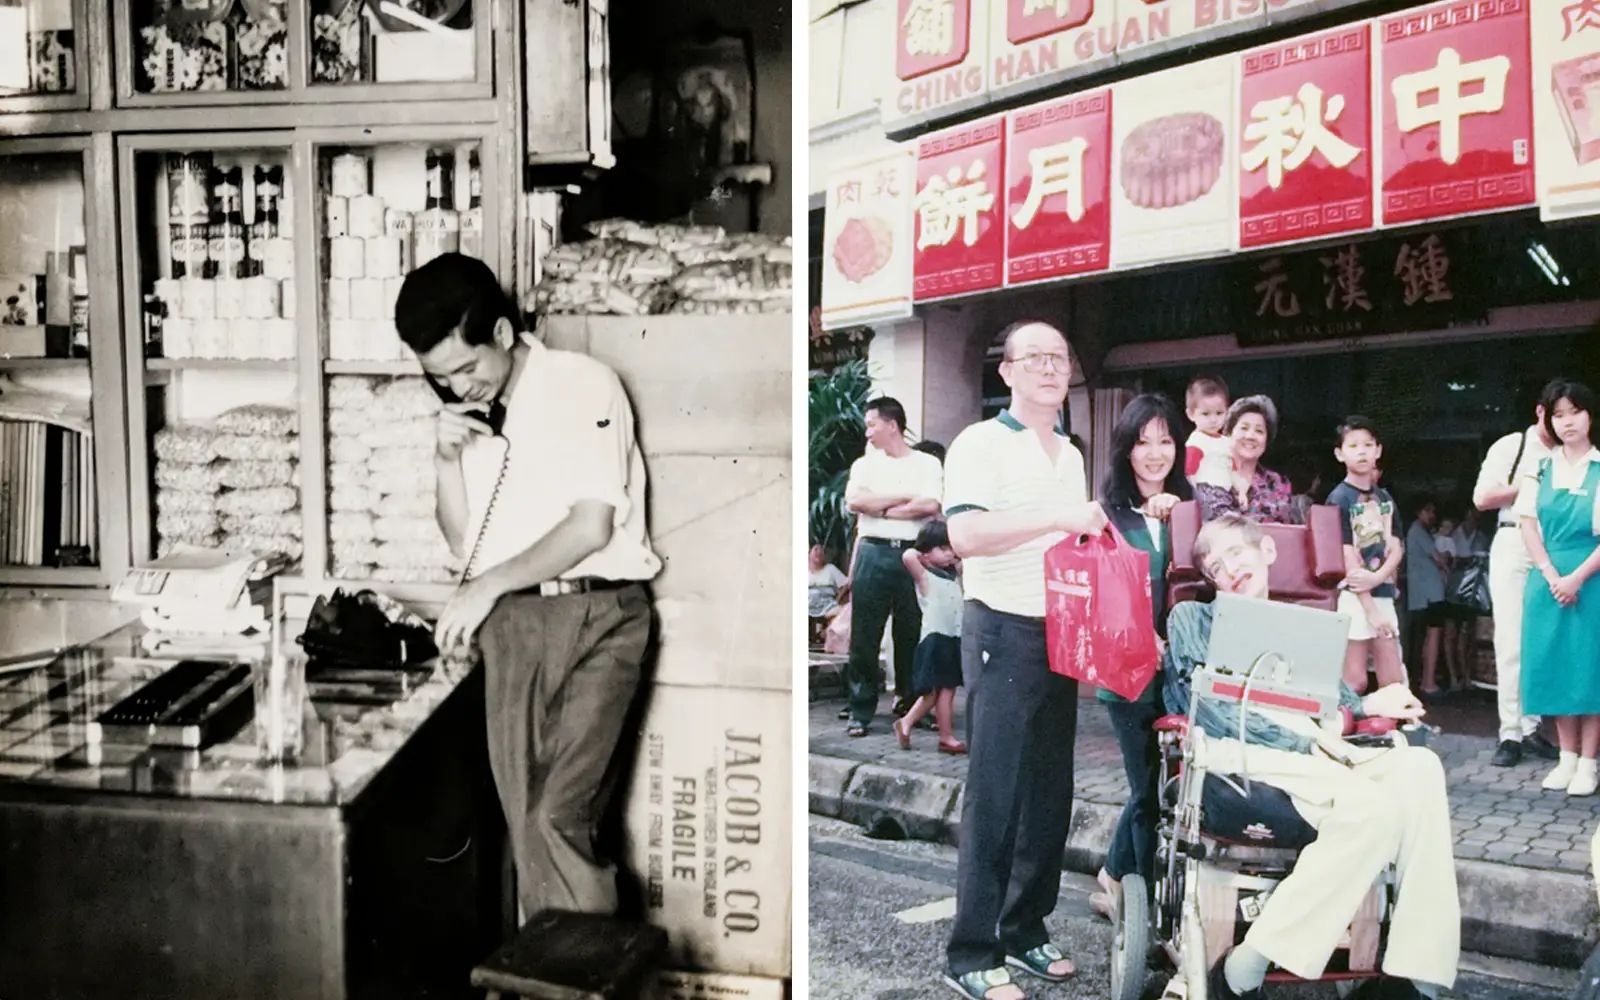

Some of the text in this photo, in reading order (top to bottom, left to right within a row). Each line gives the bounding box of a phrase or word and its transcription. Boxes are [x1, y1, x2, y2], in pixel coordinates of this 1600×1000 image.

[896, 0, 1288, 114] CHING HAN GUAN BIS
[672, 775, 697, 881] FRAGILE
[723, 728, 762, 939] JACOB & CO.
[703, 862, 718, 919] ENGLAND
